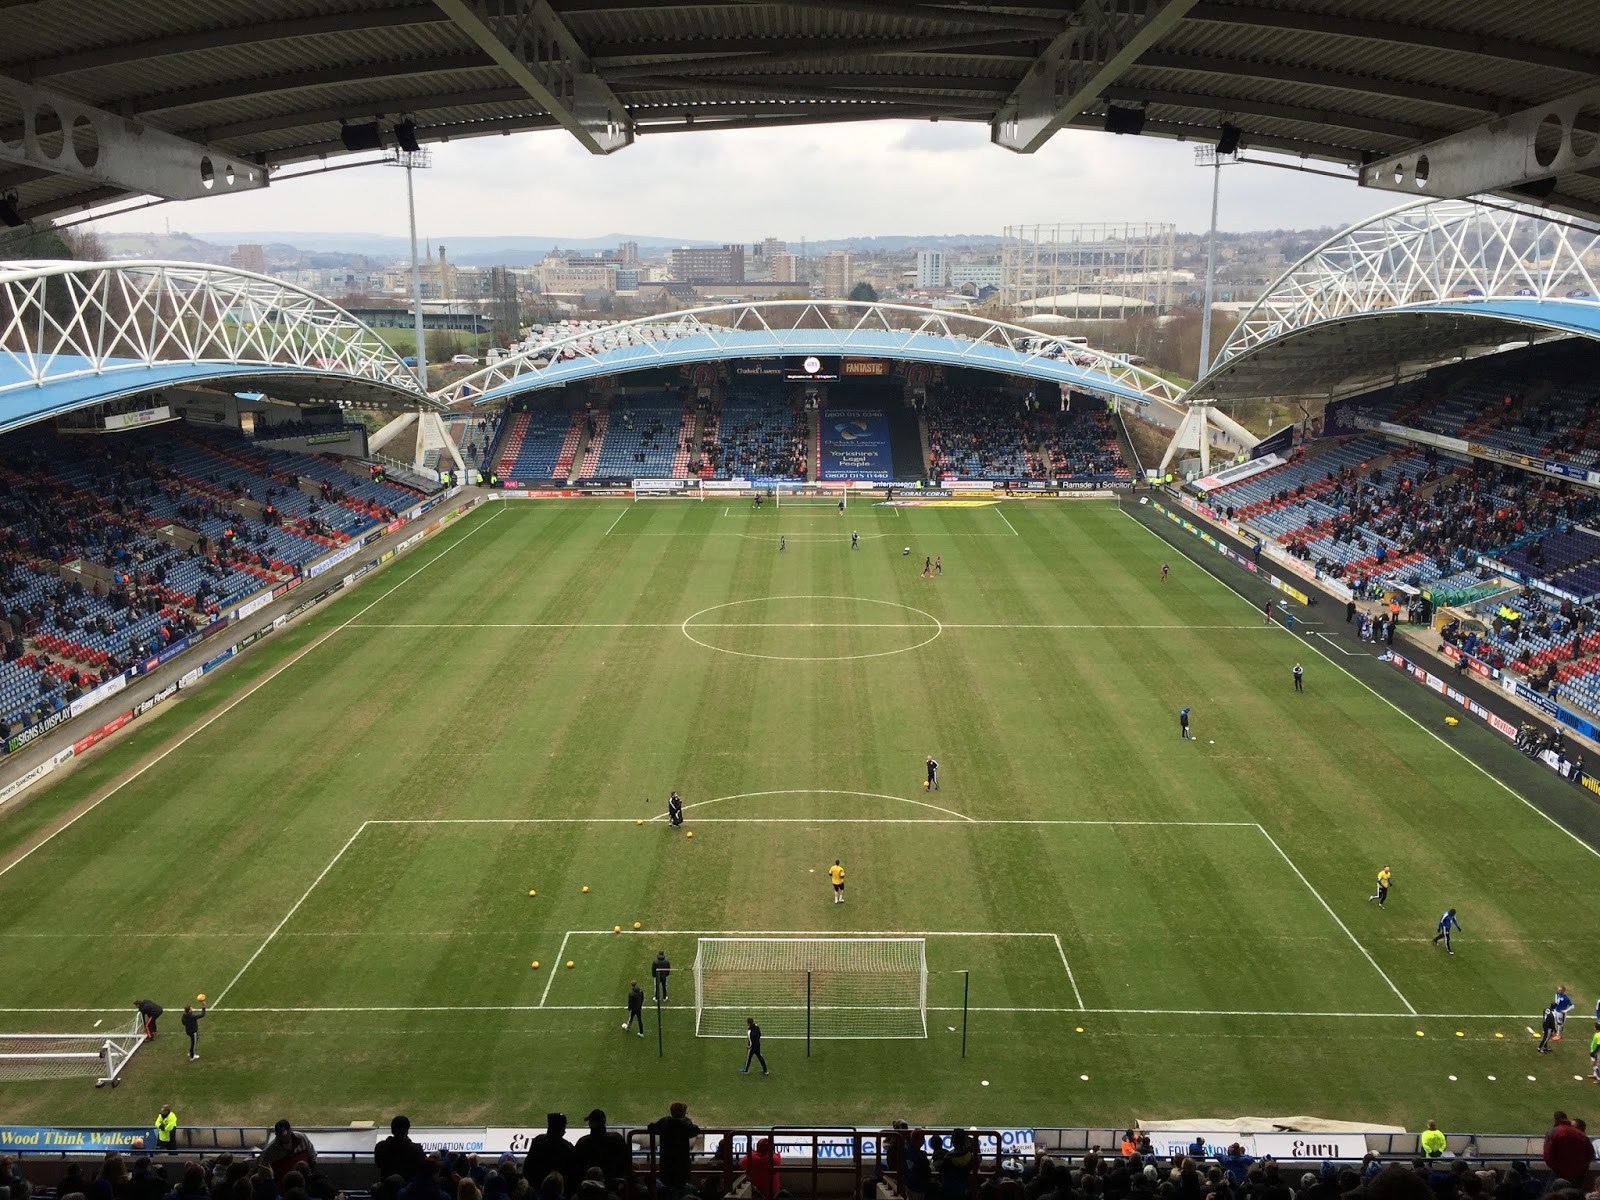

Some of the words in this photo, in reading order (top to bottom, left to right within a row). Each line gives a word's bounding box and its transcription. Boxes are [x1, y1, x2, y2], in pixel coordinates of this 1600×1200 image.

[846, 363, 883, 373] FANTASTIC
[1063, 481, 1100, 489] Ramsdes
[1102, 481, 1131, 489] Solicitor
[39, 722, 45, 734] &
[44, 706, 71, 731] DISPLAY
[1494, 717, 1515, 736] DEVELOP
[1, 1131, 39, 1145] Wood
[43, 1131, 86, 1145] Think
